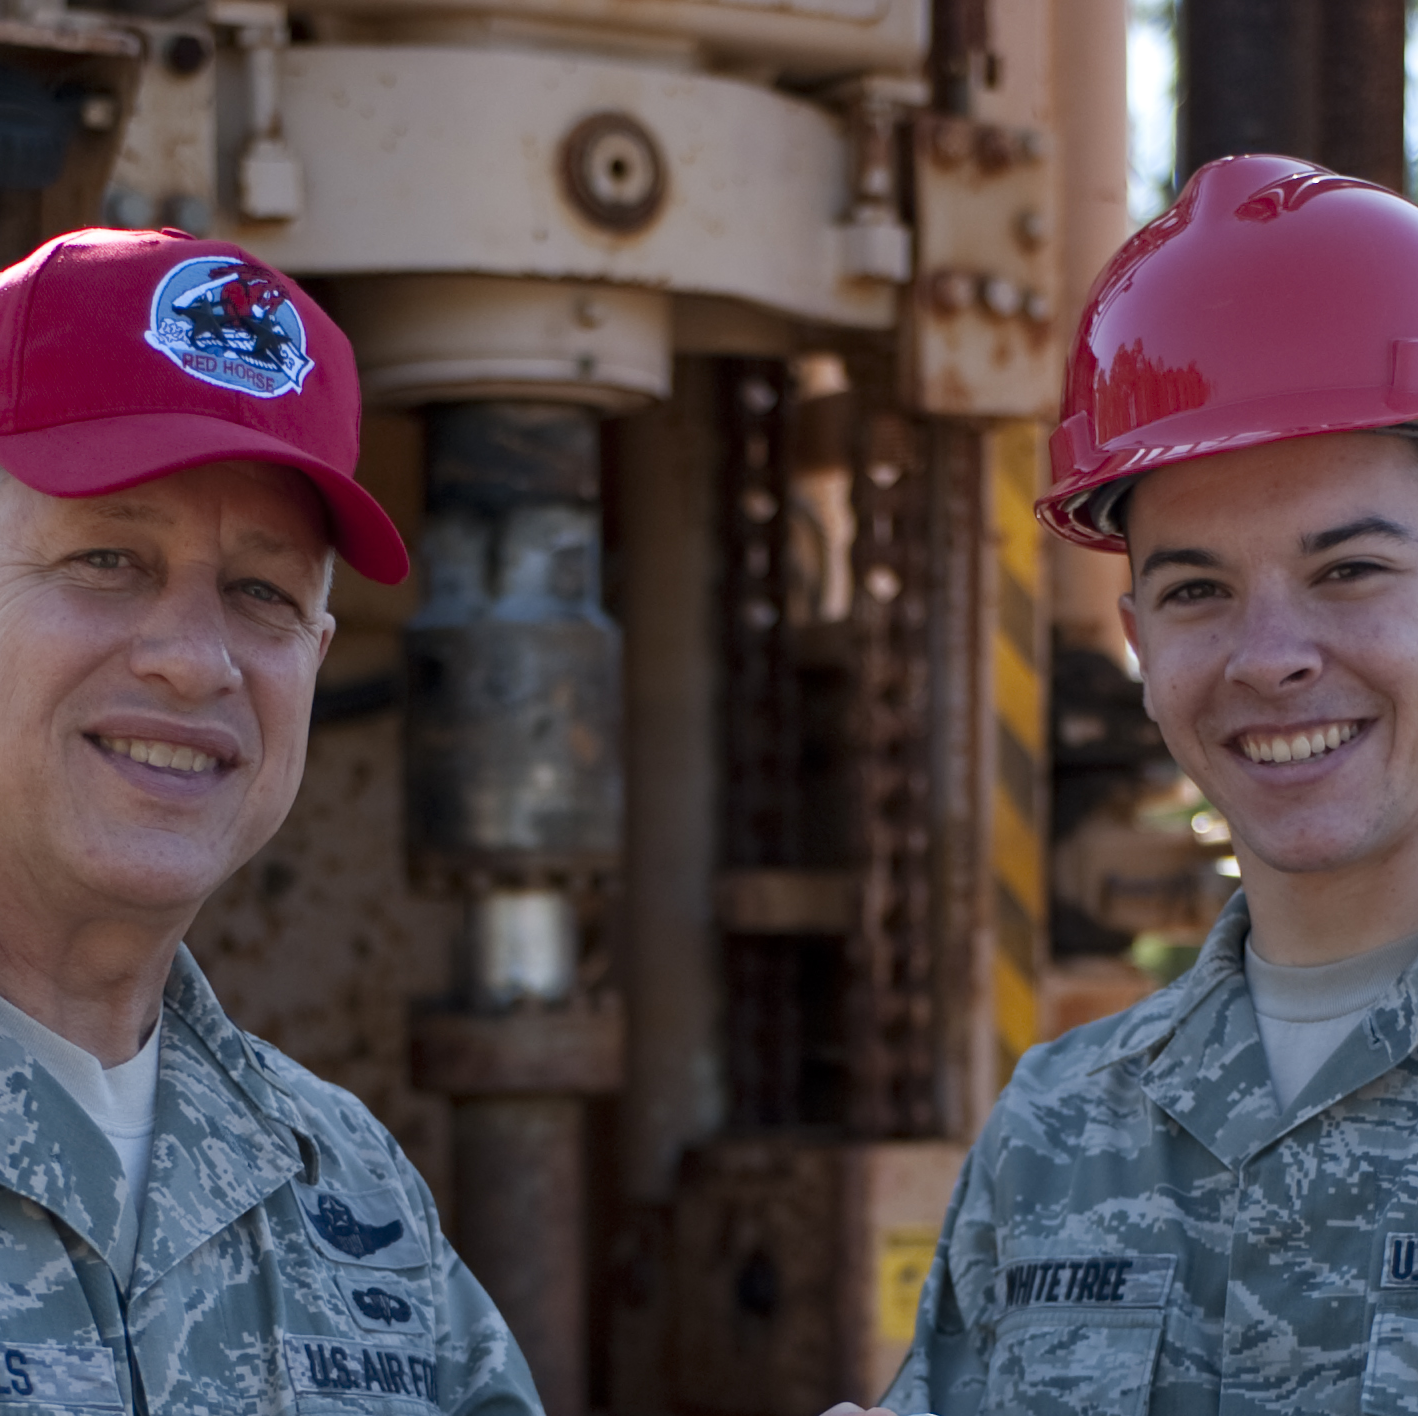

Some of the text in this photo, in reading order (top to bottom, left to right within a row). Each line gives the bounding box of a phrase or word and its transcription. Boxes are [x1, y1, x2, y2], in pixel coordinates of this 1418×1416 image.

[182, 351, 275, 394] RED HORSE
[1006, 1259, 1134, 1307] WHITETREE
[303, 1343, 439, 1406] U.S. AIR FO
